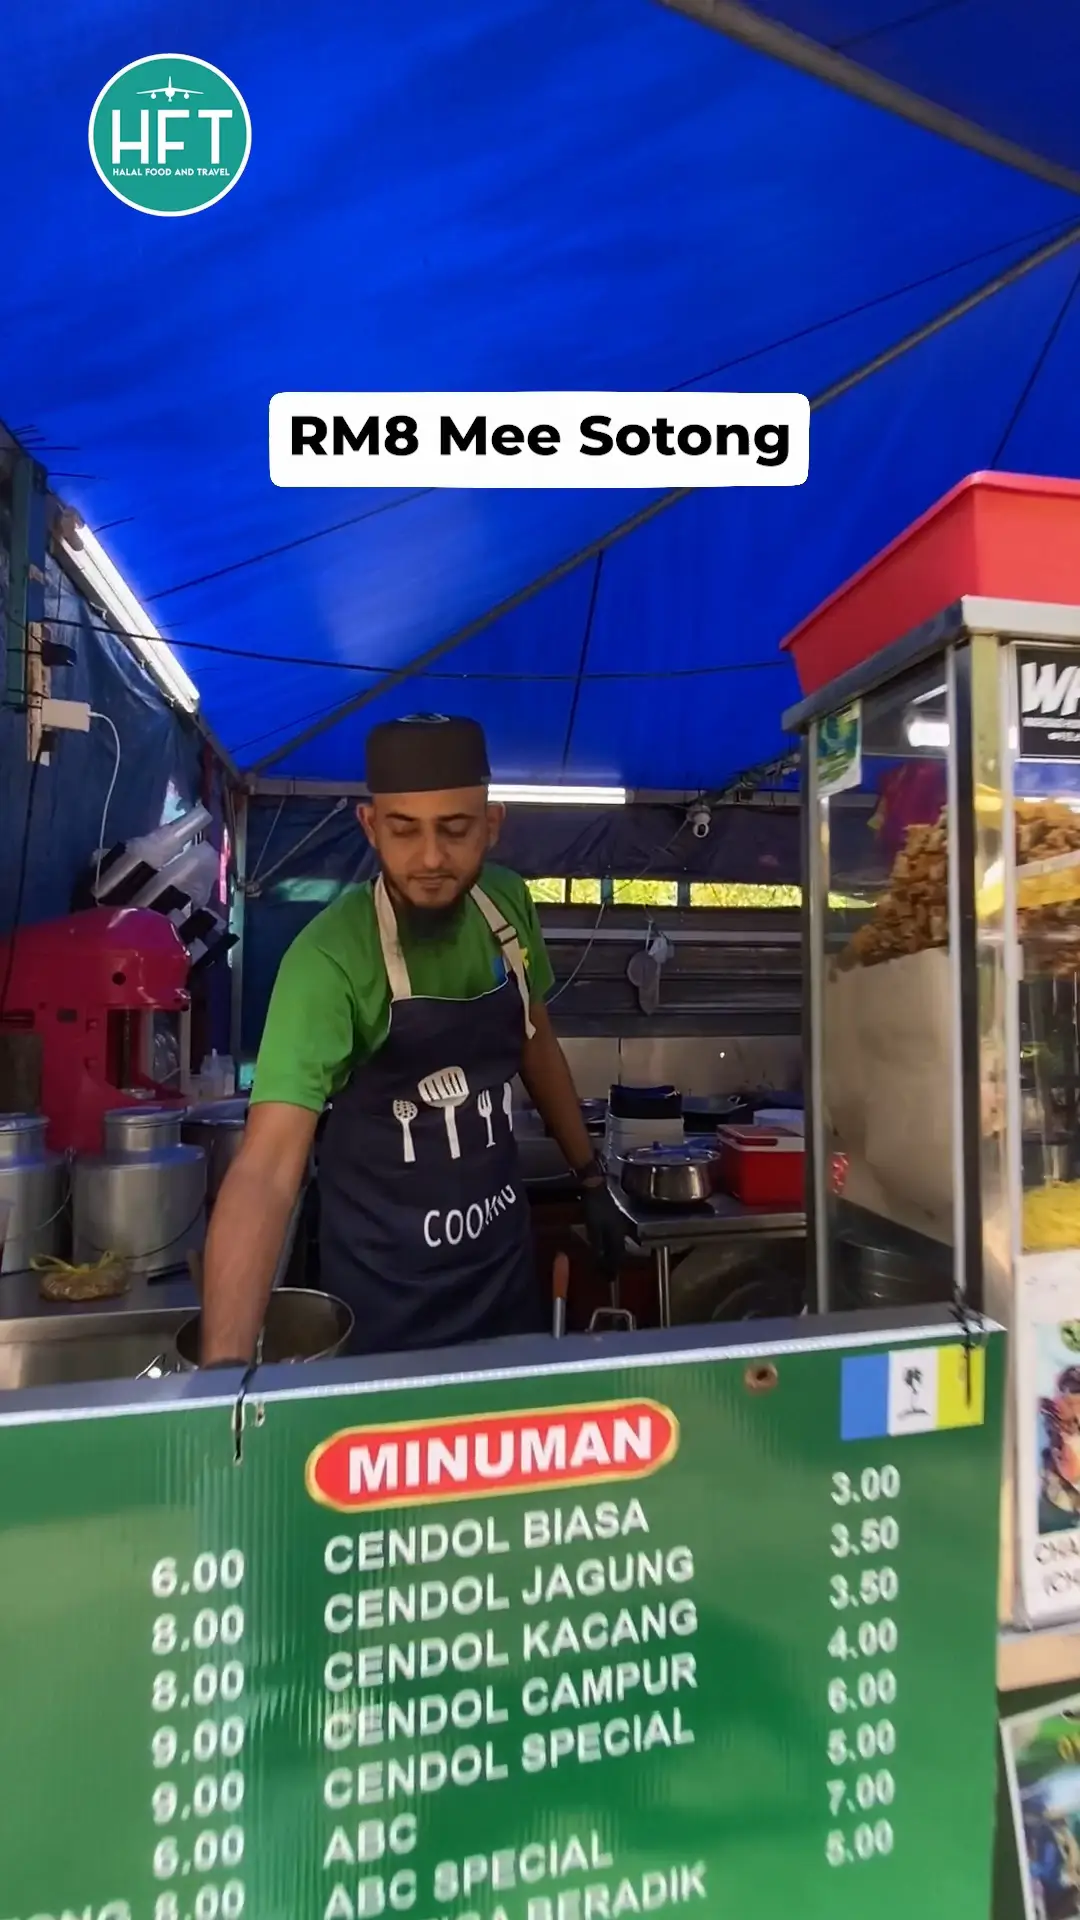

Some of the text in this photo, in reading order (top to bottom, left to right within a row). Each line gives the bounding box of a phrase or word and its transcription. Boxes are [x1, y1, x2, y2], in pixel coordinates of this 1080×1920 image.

[350, 1416, 652, 1494] MINUMAN
[830, 1464, 901, 1506] 3.00
[324, 1498, 650, 1575] CENDOL BIASA
[830, 1516, 900, 1558] 3.50
[152, 1549, 245, 1598] 6.00
[324, 1545, 695, 1634] CENDOL JAGUNG
[829, 1566, 899, 1610] 3.50
[152, 1605, 245, 1655] 8.00
[324, 1598, 699, 1692] CENDOL KACANG
[827, 1617, 898, 1661] 4.00
[152, 1660, 245, 1711] 8.00
[324, 1653, 698, 1750] CENDOL CAMPUR
[827, 1668, 897, 1714] 6.00
[152, 1715, 245, 1769] 9.00
[324, 1706, 695, 1808] CENDOL SPECIAL
[827, 1719, 896, 1766] 5.00
[152, 1770, 245, 1825] 9.00
[826, 1769, 896, 1816] 7.00
[152, 1825, 245, 1880] 6.00
[323, 1812, 418, 1869] ABC
[323, 1830, 613, 1920] ABC SPECIAL
[527, 1861, 706, 1920] BERADIK
